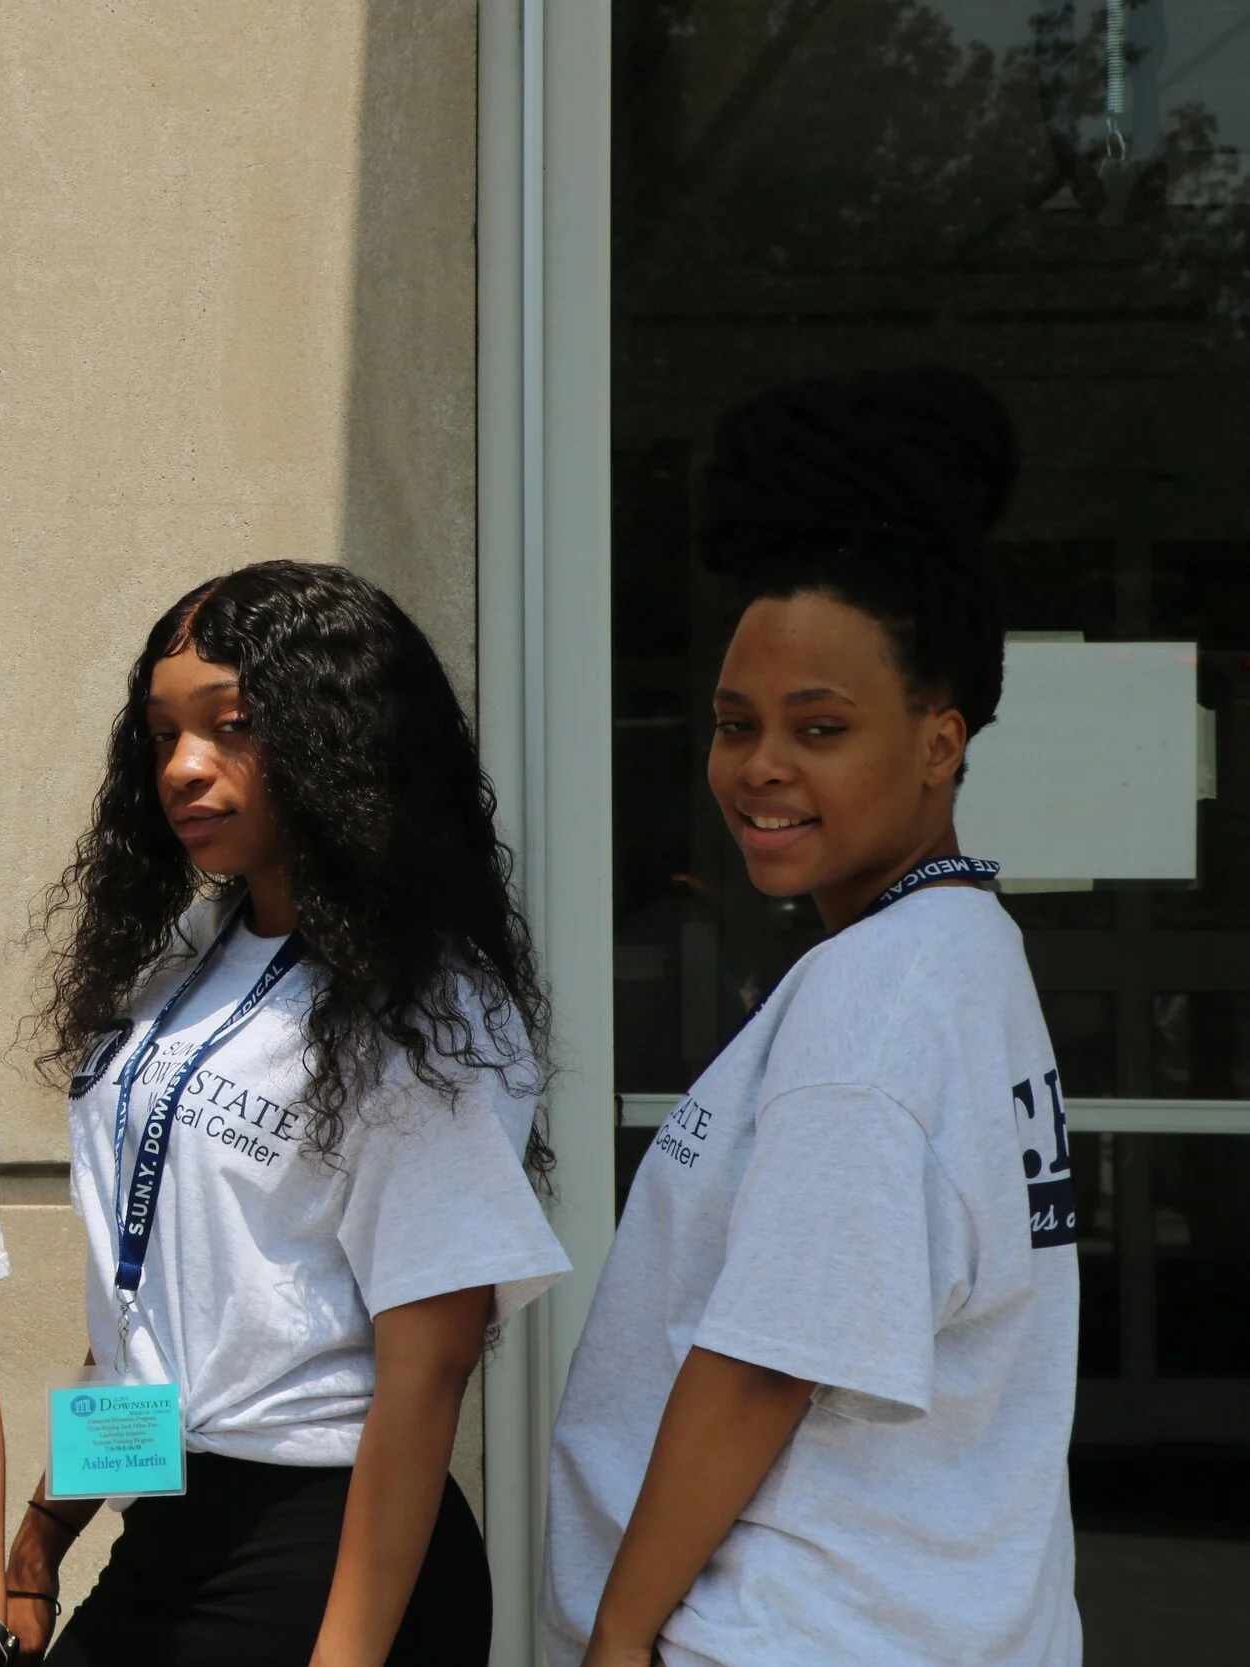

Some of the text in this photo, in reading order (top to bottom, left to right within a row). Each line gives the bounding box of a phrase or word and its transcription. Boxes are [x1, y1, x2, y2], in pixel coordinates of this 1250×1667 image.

[880, 859, 971, 901] MEDICAL
[163, 1041, 196, 1057] SUN
[113, 1041, 299, 1142] DOWSTATE
[206, 1115, 280, 1167] Center
[656, 1124, 700, 1168] Center
[128, 1160, 158, 1237] S.U.N.Y.
[82, 1453, 166, 1471] Ashley Martin
